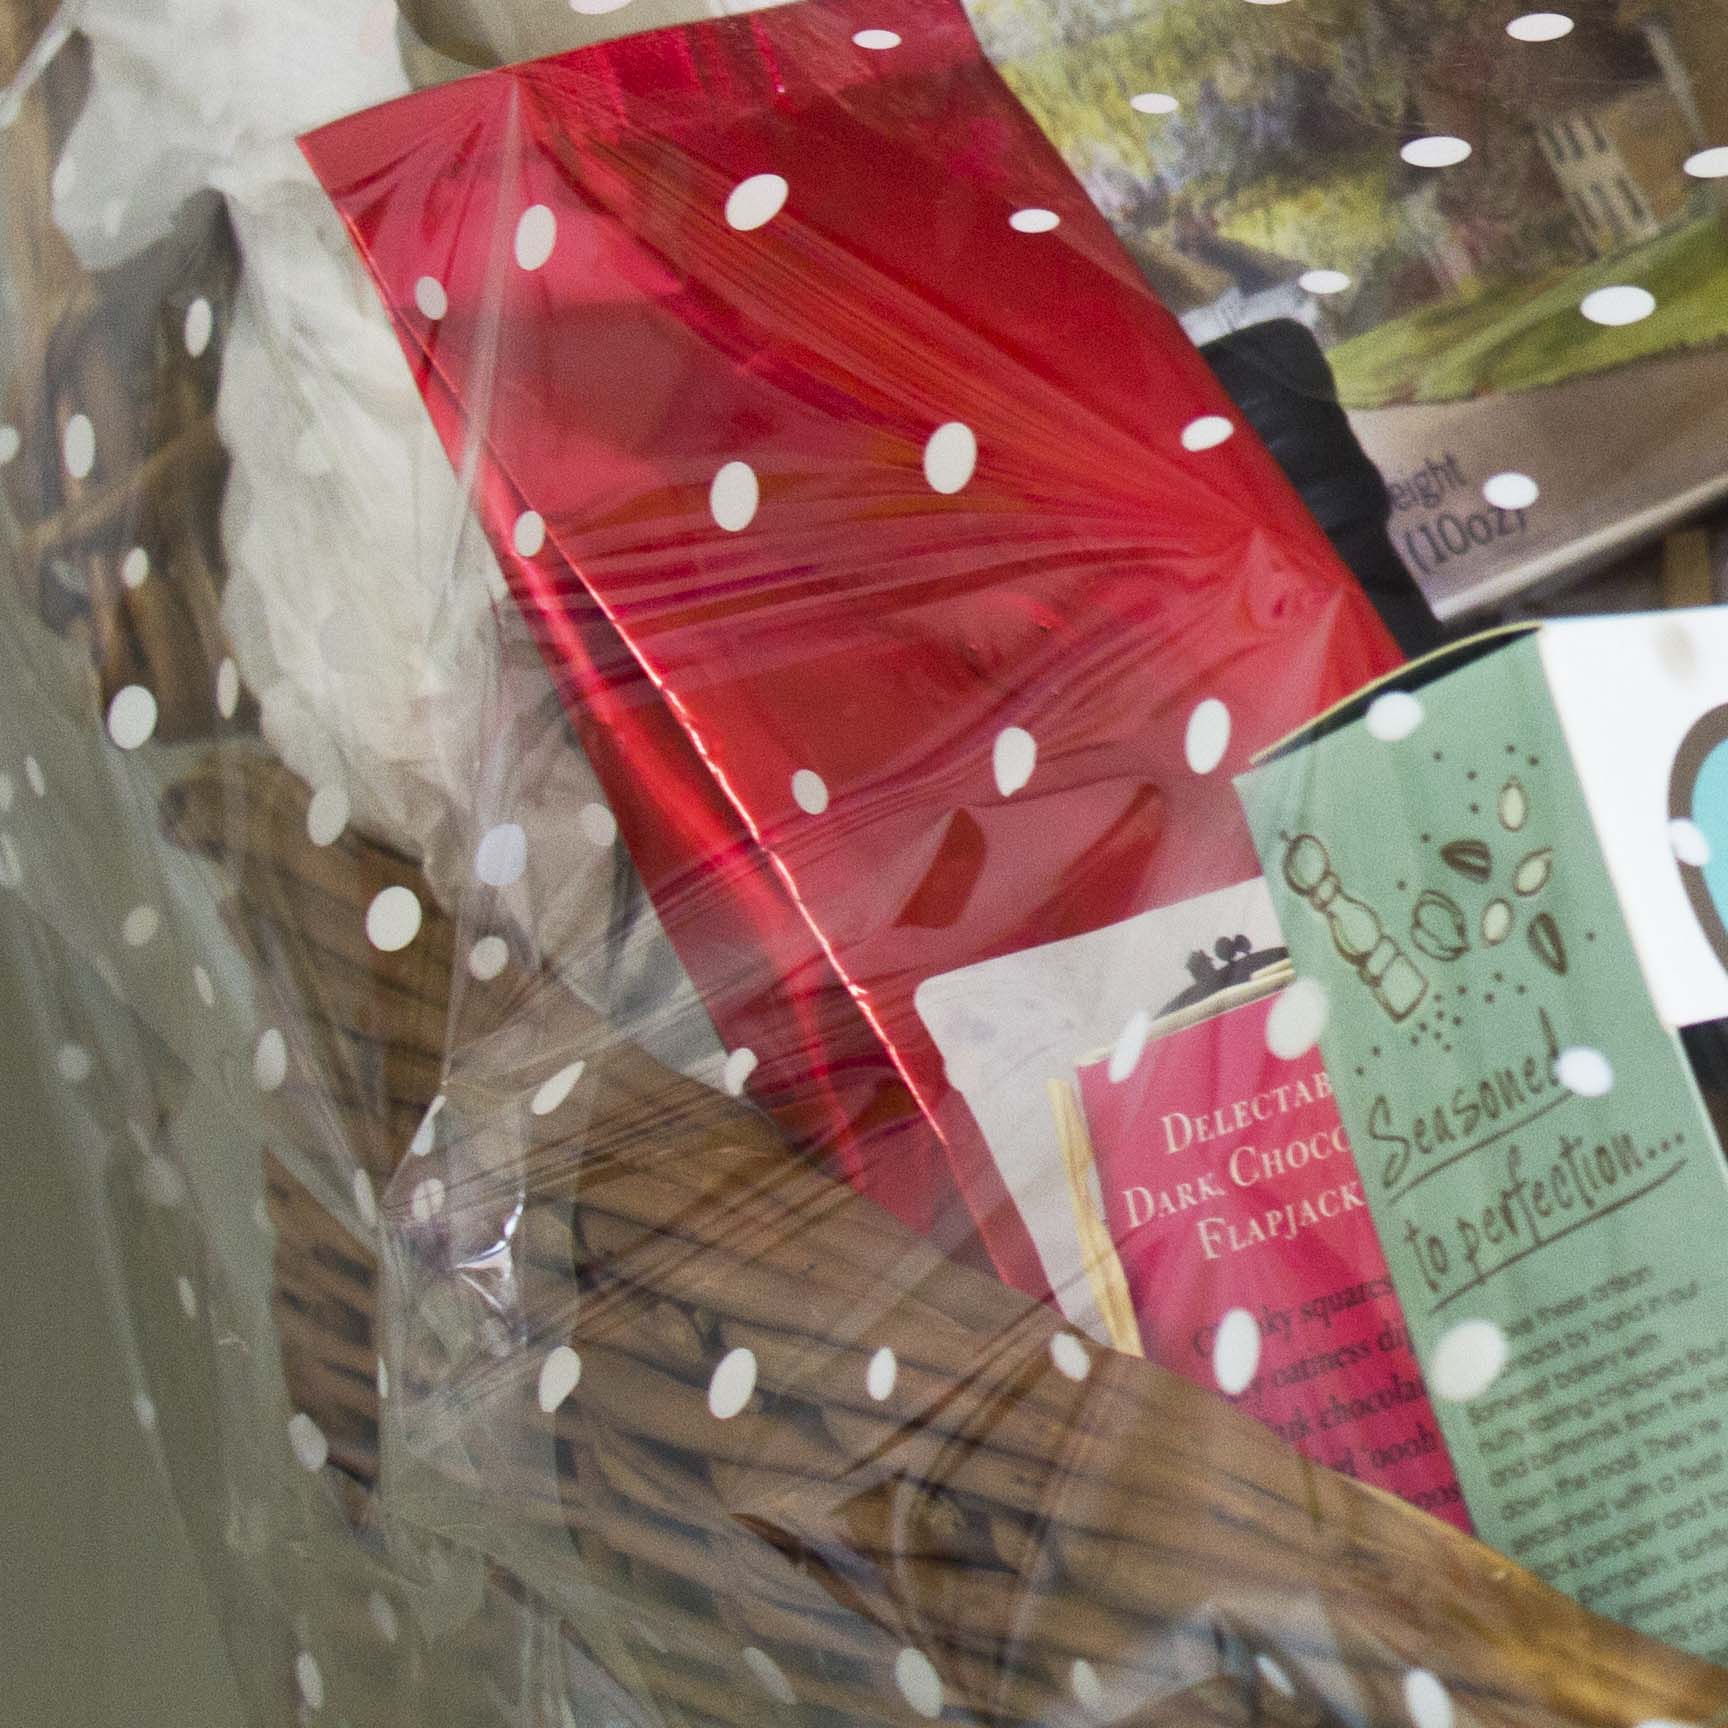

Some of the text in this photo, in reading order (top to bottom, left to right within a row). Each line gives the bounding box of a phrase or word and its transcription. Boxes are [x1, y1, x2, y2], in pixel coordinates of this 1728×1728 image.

[1160, 1071, 1335, 1155] DELECTAB
[1121, 1172, 1224, 1229] DARK
[1405, 1219, 1449, 1296] to
